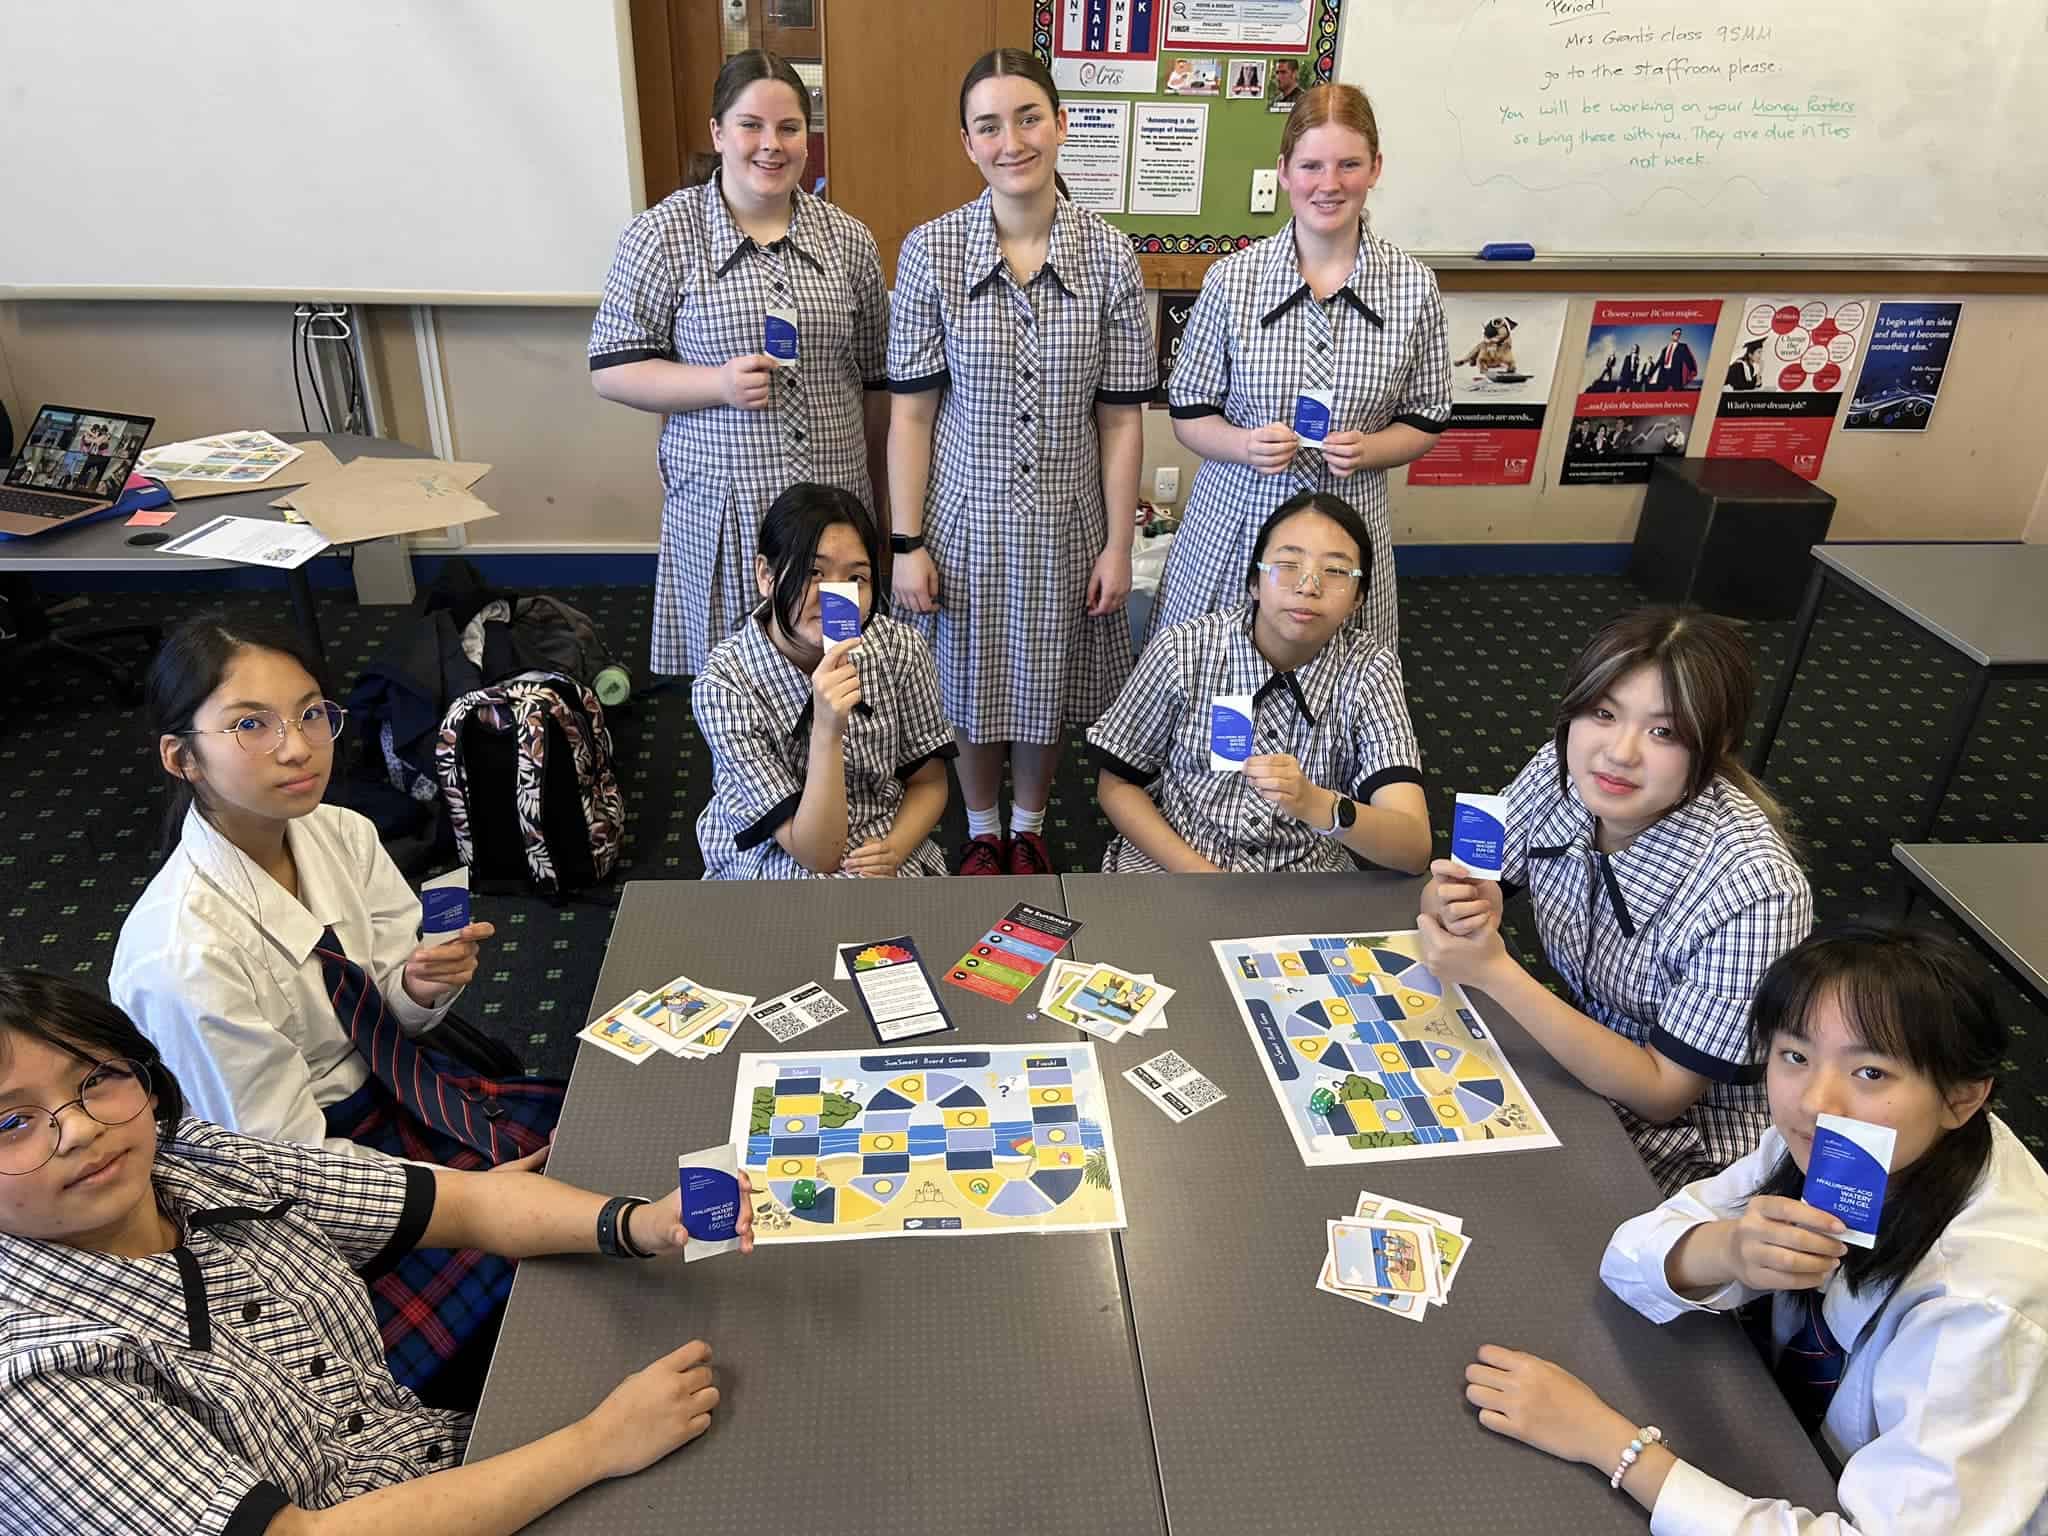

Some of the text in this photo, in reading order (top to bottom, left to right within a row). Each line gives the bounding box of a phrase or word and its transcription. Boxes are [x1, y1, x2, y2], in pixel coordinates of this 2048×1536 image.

[1564, 33, 1593, 48] Mrs
[1661, 25, 1703, 42] class
[1539, 71, 1560, 90] go
[1568, 65, 1585, 80] to
[1592, 63, 1624, 79] the
[1632, 57, 1721, 85] staffroom
[1499, 104, 1525, 125] You
[1539, 98, 1569, 115] will
[1582, 95, 1601, 113] be
[1610, 99, 1674, 123] working
[1681, 103, 1701, 112] on
[1708, 101, 1743, 120] your
[1513, 132, 1529, 145] so
[1537, 130, 1574, 154] bring
[1624, 126, 1654, 142] with
[1692, 125, 1725, 150] They
[1733, 129, 1759, 140] are
[1765, 121, 1796, 139] due
[1802, 123, 1816, 138] in
[1601, 308, 1630, 319] Choose
[1630, 310, 1650, 320] your
[1885, 316, 1906, 329] begin
[1907, 316, 1924, 327] with
[1925, 318, 1936, 327] an
[1937, 317, 1953, 327] idea
[1873, 329, 1950, 339] and then it becomes
[1870, 342, 1910, 353] something
[884, 1056, 968, 1067] SunSmart Board Game
[1815, 1177, 1857, 1193] HYALURONIC
[1839, 1196, 1856, 1206] SUN
[1840, 1189, 1873, 1203] WATERY
